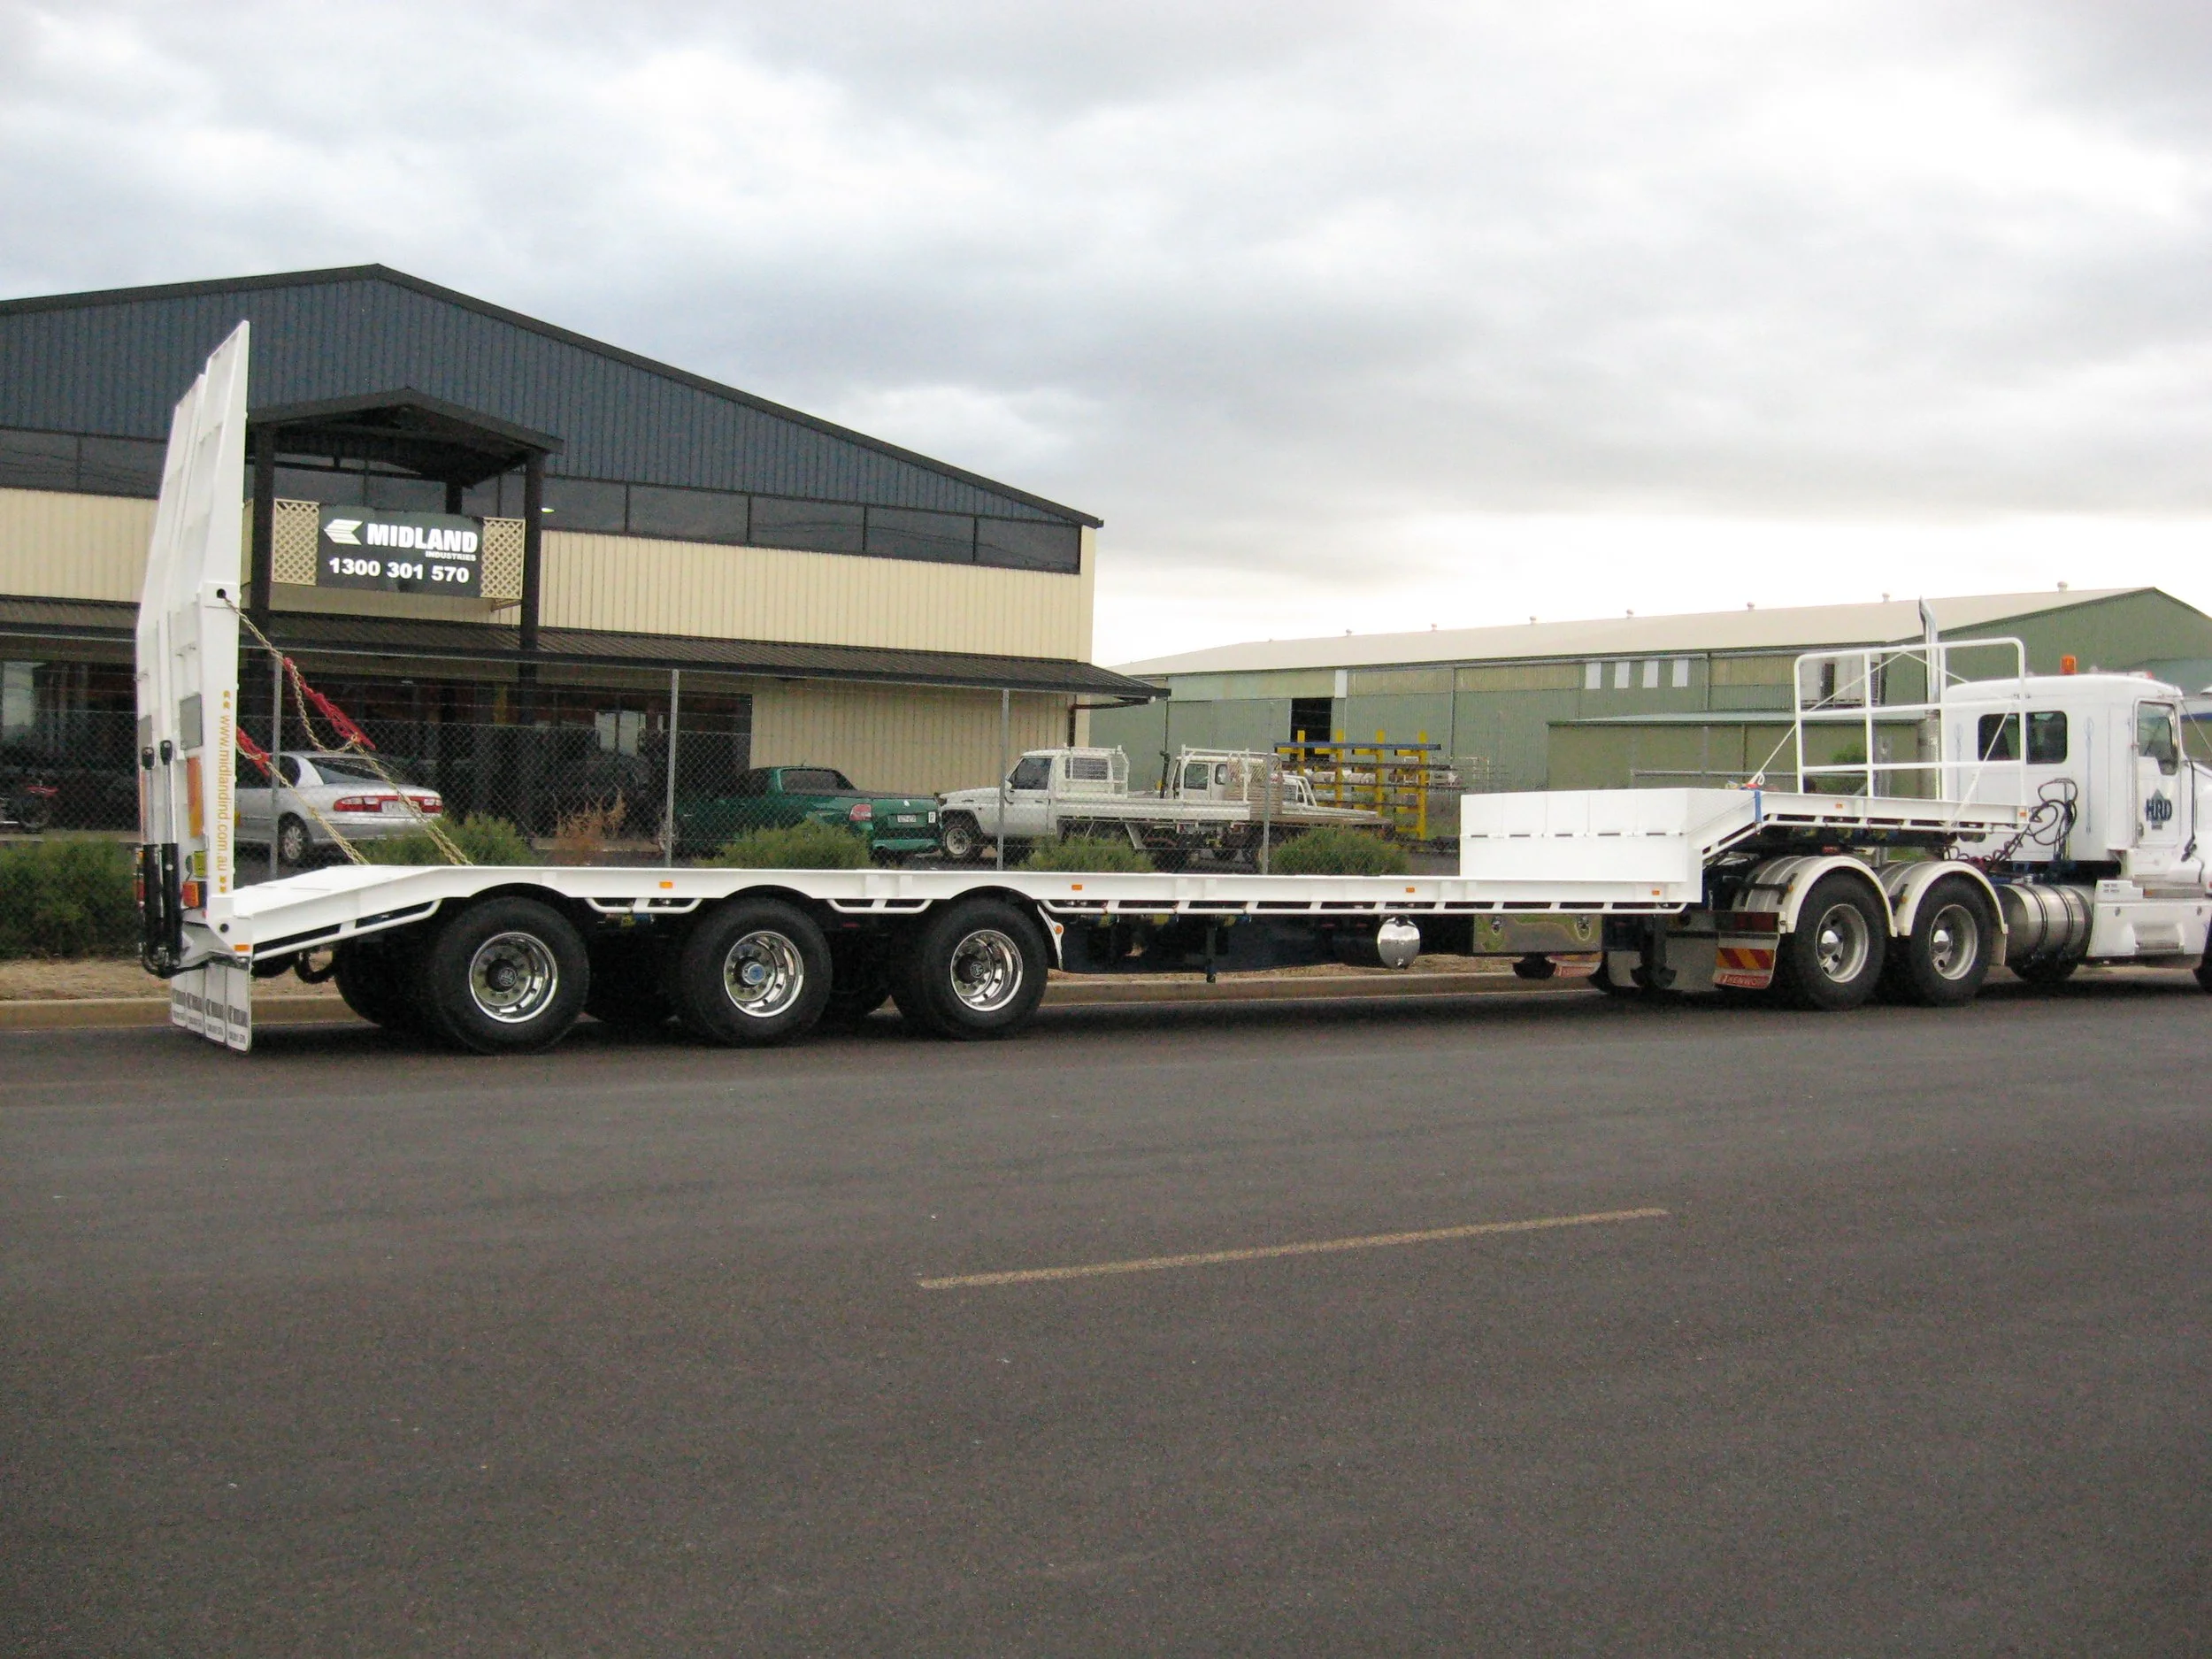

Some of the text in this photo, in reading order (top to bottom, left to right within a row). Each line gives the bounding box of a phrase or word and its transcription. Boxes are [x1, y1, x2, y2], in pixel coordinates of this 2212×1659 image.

[366, 523, 478, 552] MIDLAND
[425, 550, 476, 561] INDUSTRIES
[329, 557, 470, 584] 1300 301 570
[217, 714, 234, 871] www.midlandind.com.au
